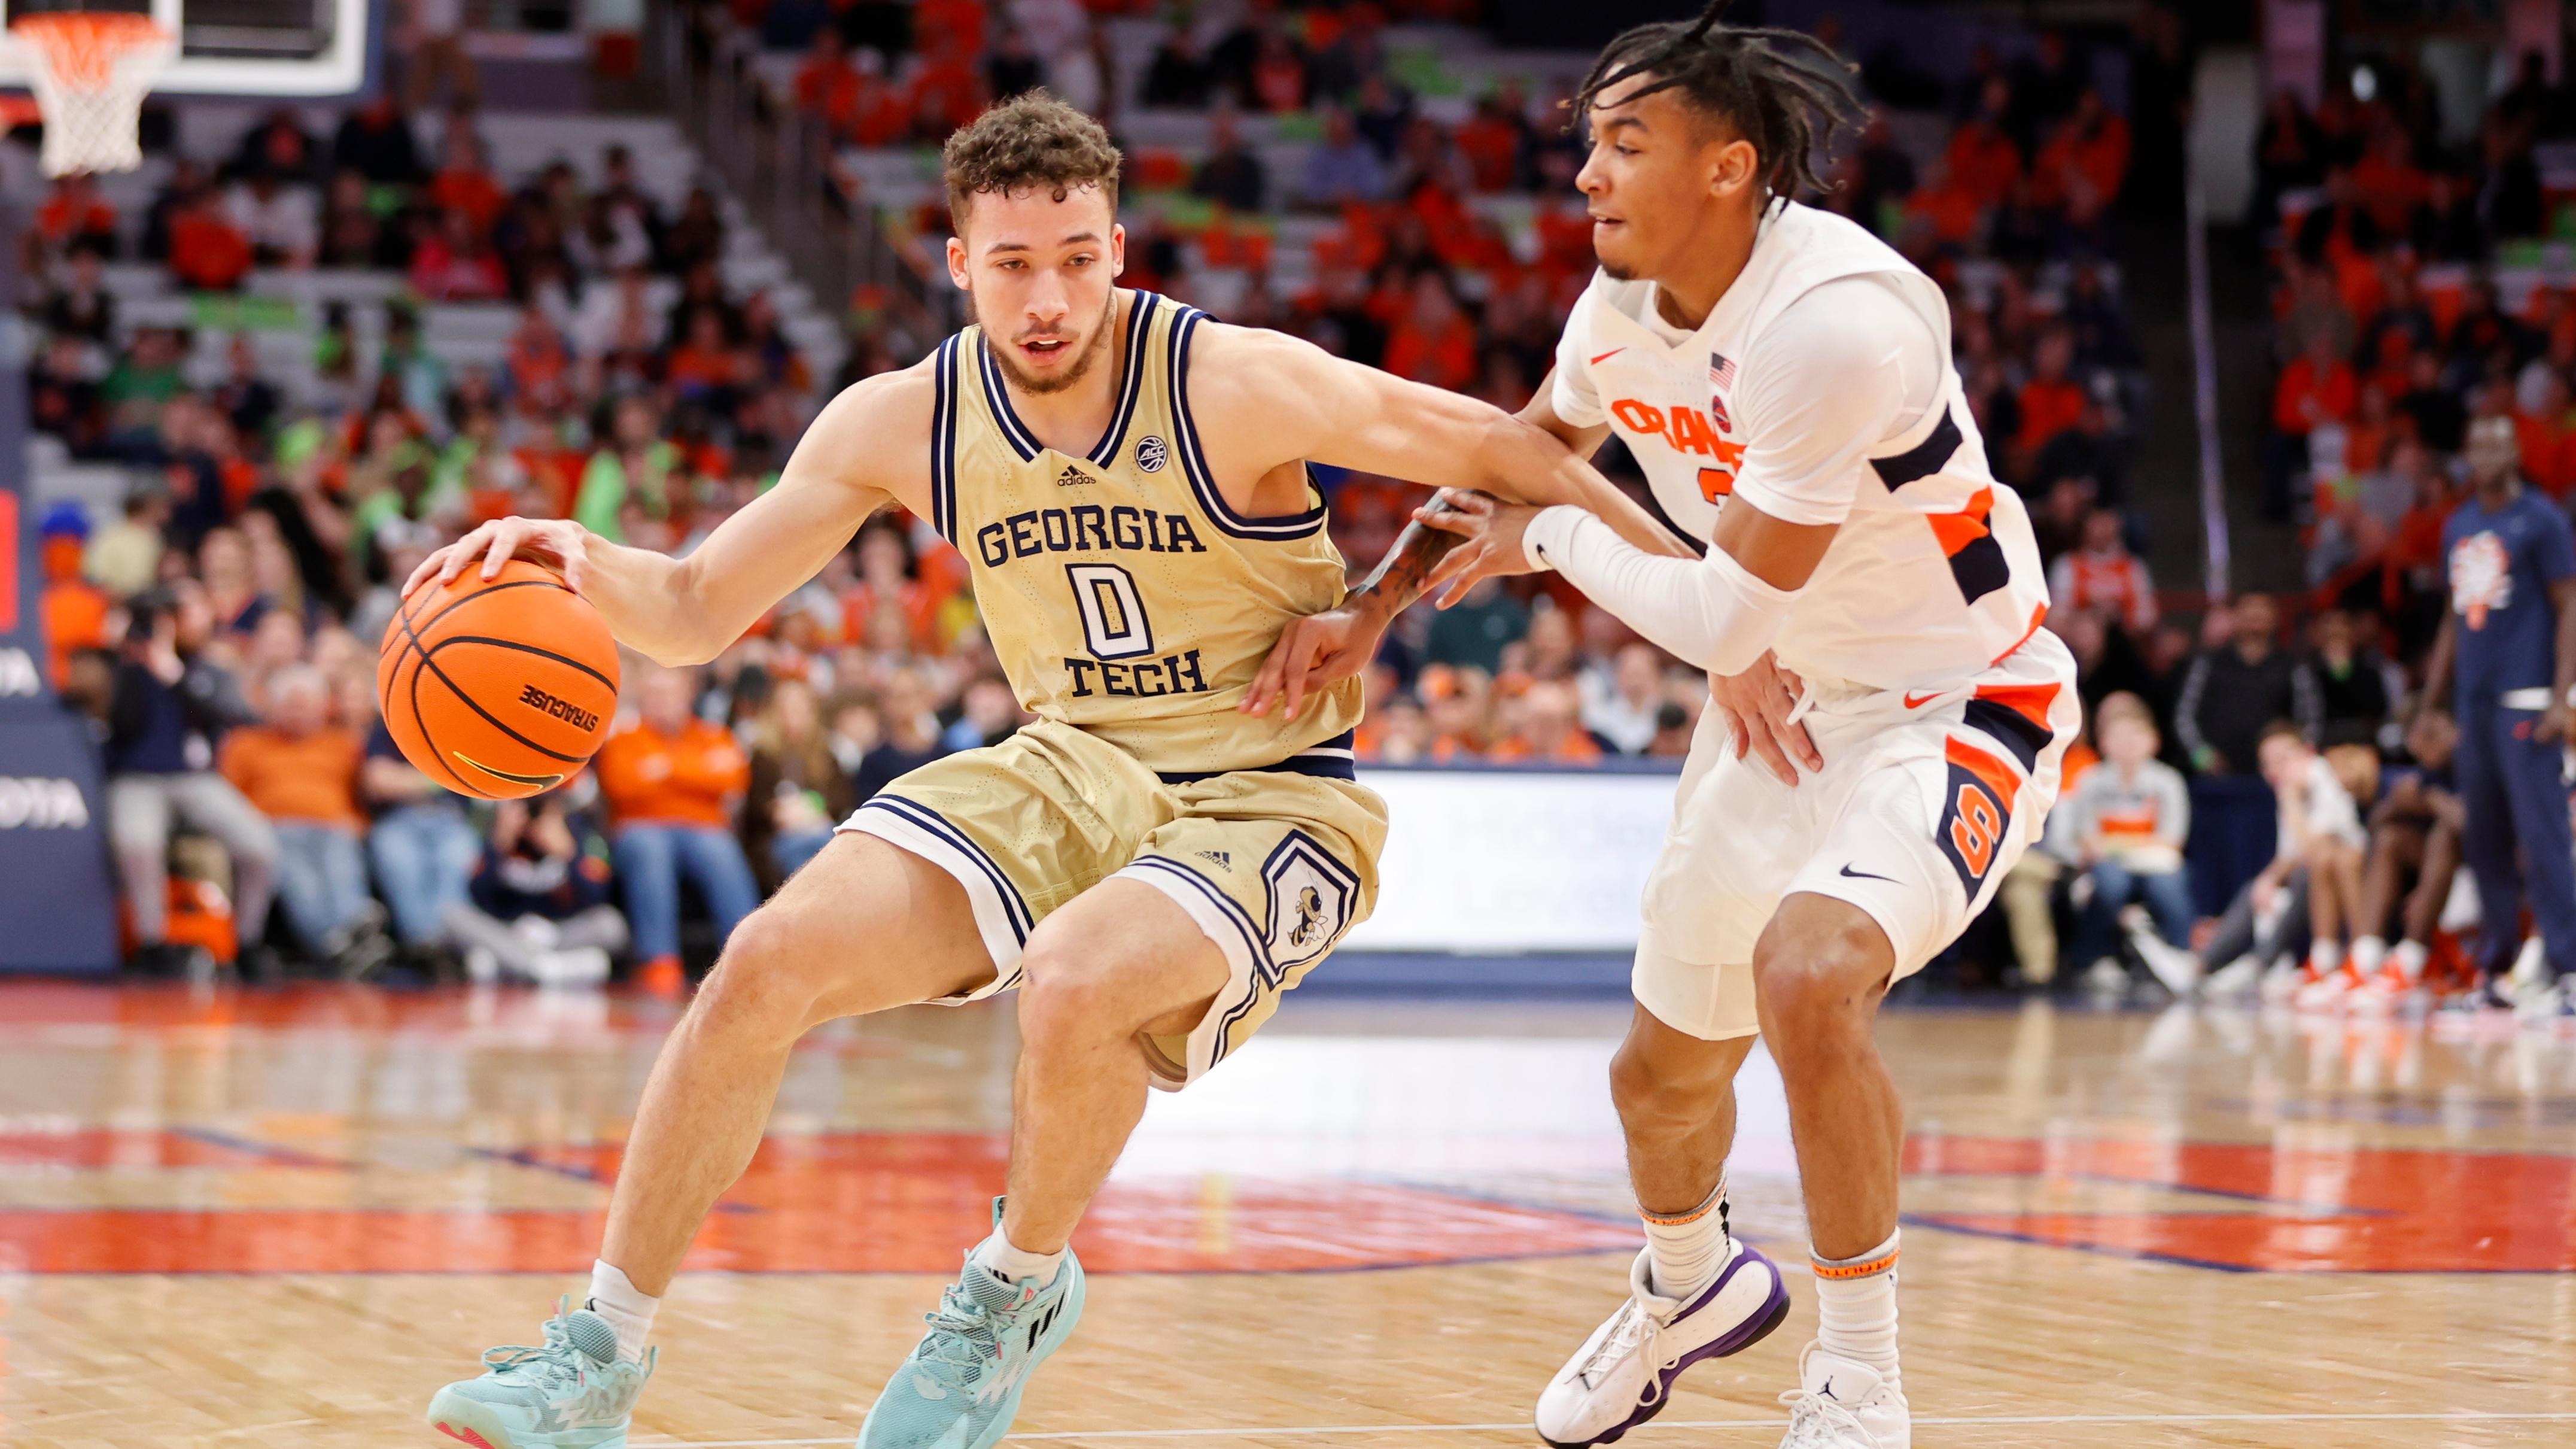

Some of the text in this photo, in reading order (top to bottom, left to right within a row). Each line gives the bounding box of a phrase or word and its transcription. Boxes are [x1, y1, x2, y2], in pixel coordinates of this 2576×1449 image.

[1140, 445, 1165, 457] ACC
[1057, 475, 1096, 487] adidas
[977, 505, 1208, 568] GEORGIA
[1065, 563, 1155, 661] 0
[1064, 649, 1208, 697] TECH
[519, 684, 599, 733] SYRACUSE
[1950, 783, 2002, 879] S
[1194, 851, 1233, 873] adidas
